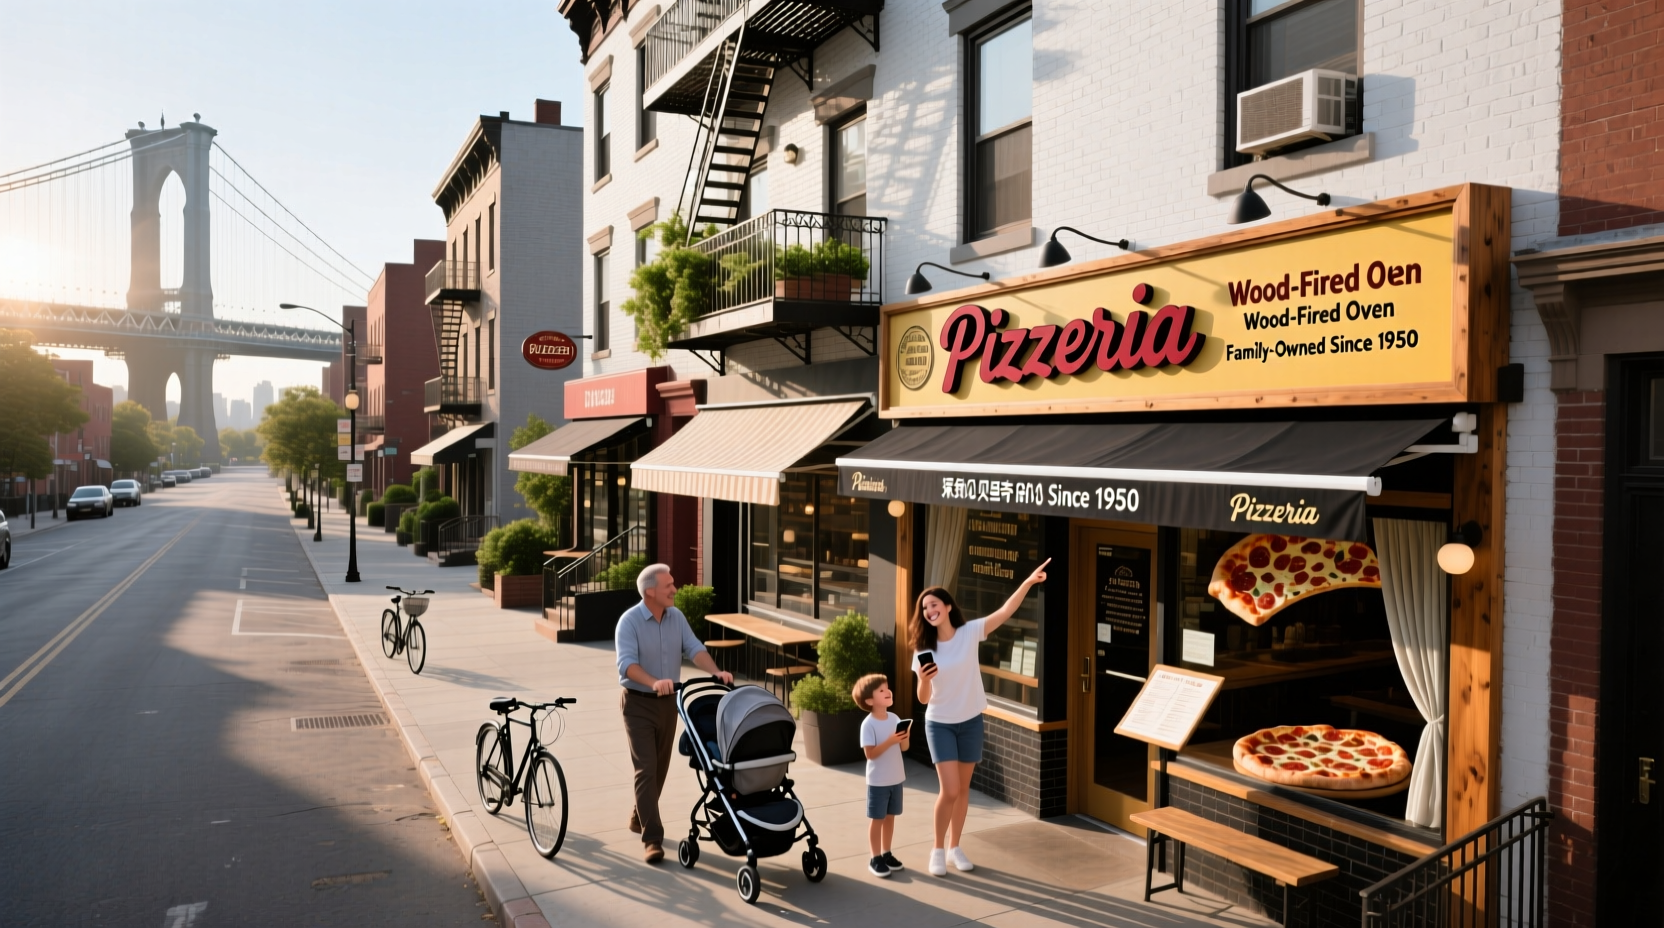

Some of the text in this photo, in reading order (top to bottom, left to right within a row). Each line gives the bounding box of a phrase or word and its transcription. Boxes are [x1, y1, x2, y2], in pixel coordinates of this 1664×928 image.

[1228, 263, 1359, 307] Wood-Fired
[1243, 300, 1395, 330] Wood-Fired Oven
[940, 283, 1206, 394] Pizzeria
[1226, 329, 1419, 363] Family-Owned Since 1950
[1047, 483, 1090, 508] Since
[1095, 487, 1139, 512] 1950
[1230, 492, 1320, 525] Pizzeria
